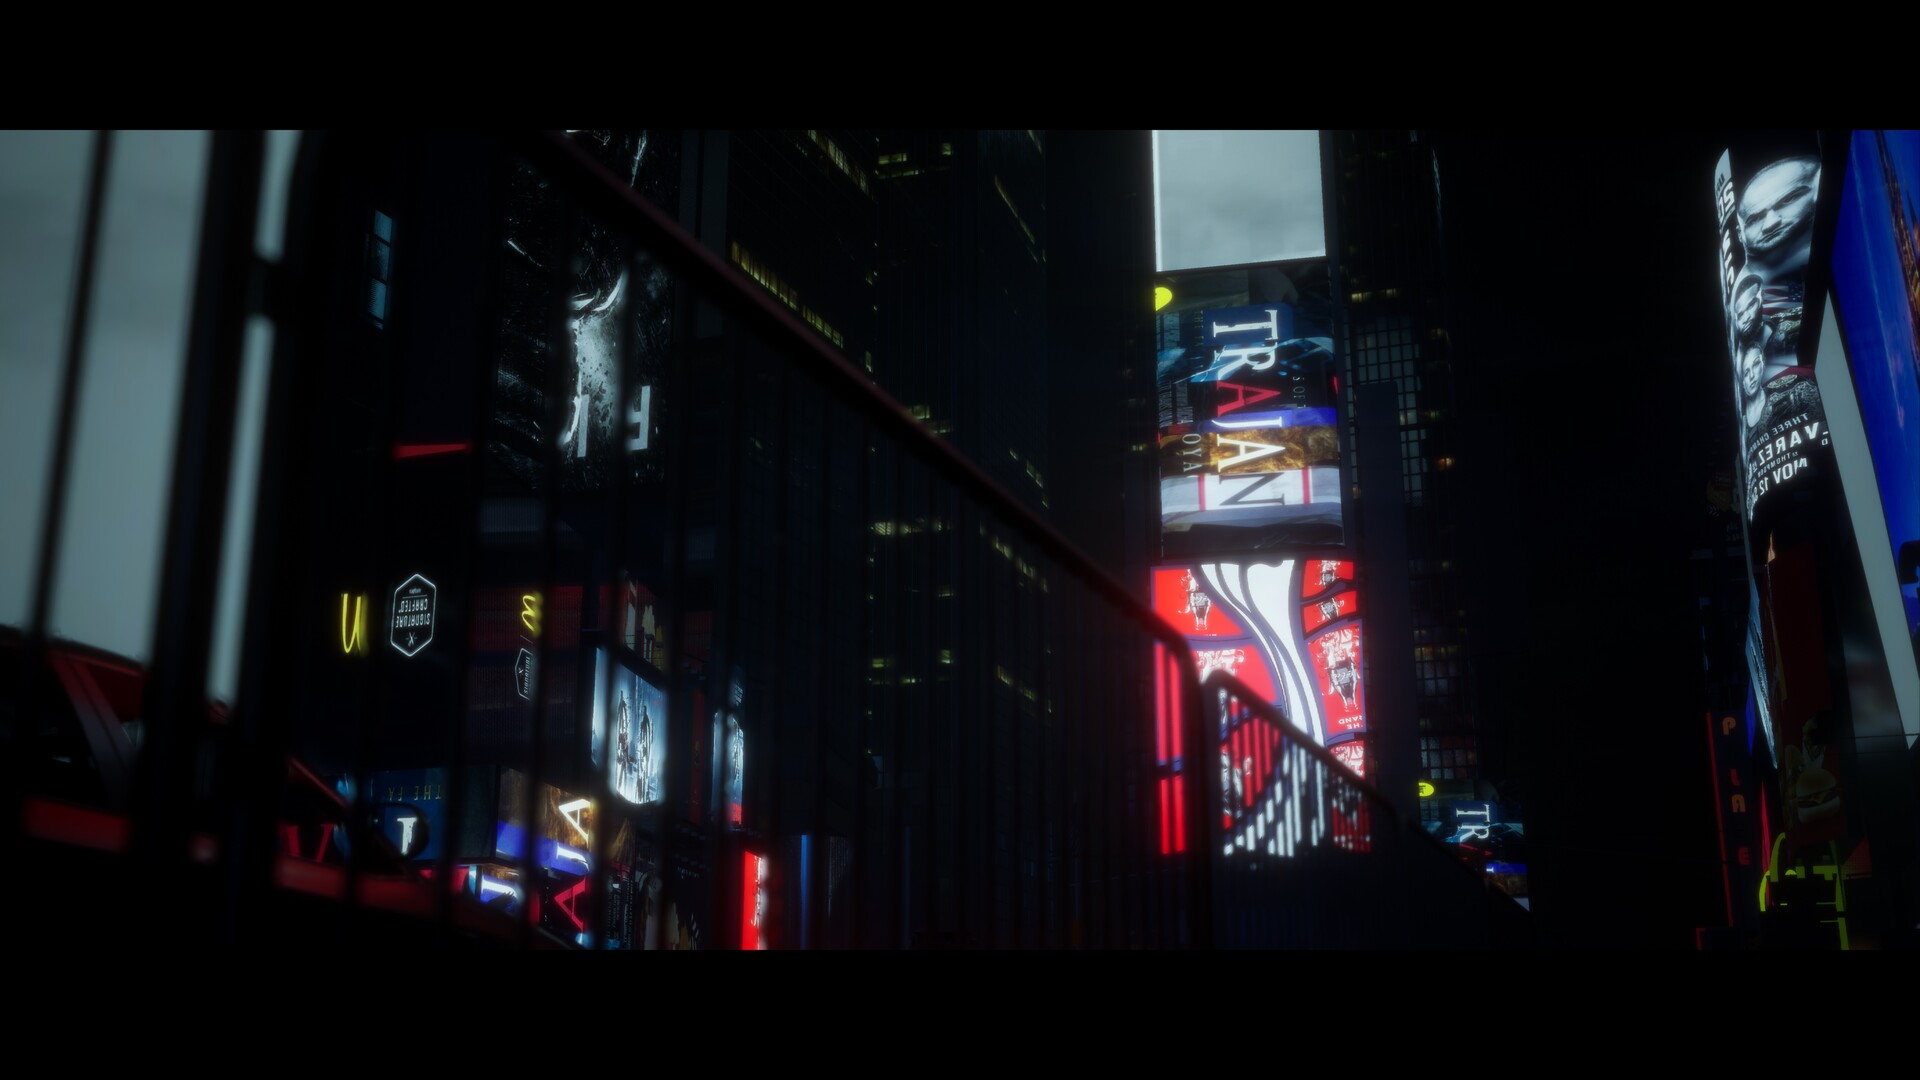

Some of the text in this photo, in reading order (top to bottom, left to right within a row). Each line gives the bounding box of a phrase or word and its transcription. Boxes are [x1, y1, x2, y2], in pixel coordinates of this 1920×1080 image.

[1211, 308, 1287, 507] TRAJAN
[1181, 433, 1203, 473] OYA
[399, 598, 428, 613] CRAFTED
[395, 613, 431, 628] SIGNATURE
[1346, 722, 1363, 730] HE
[413, 784, 442, 801] THE
